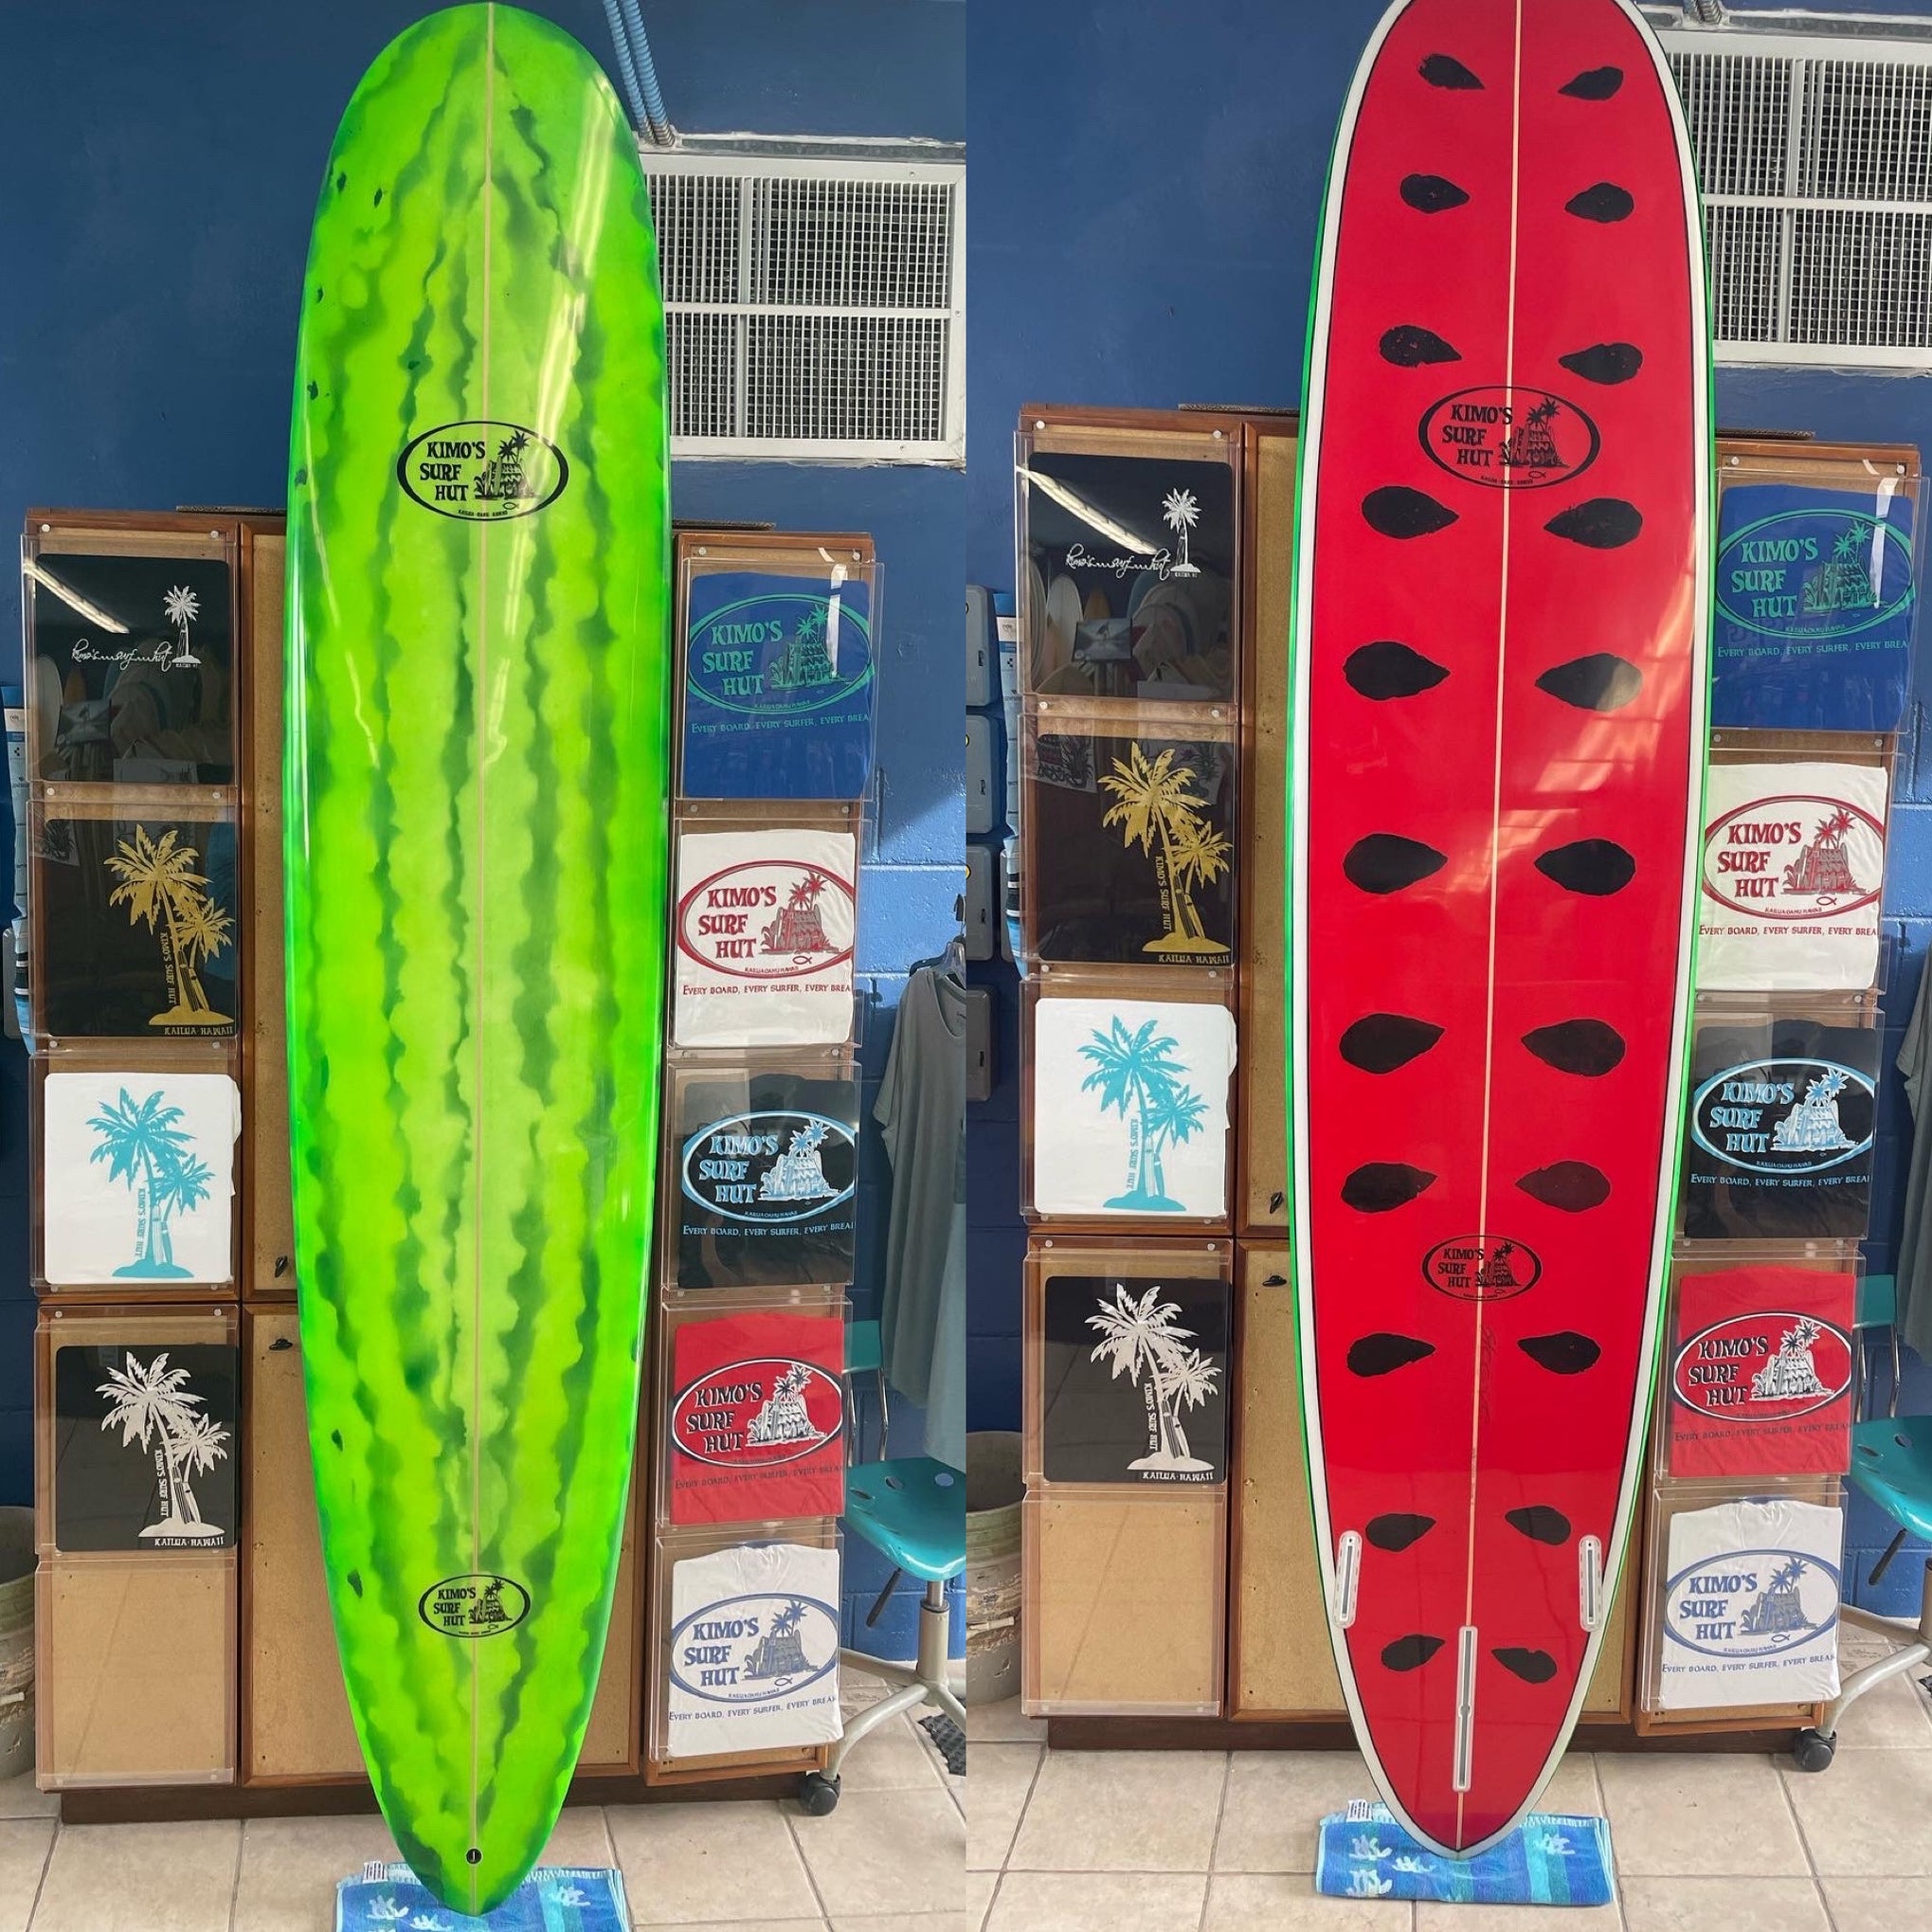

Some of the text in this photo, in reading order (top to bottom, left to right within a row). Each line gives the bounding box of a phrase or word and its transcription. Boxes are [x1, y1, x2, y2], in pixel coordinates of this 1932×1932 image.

[1451, 404, 1513, 424] KIMO'S
[1442, 425, 1487, 446] SURF
[426, 441, 486, 460] KIMO'S
[1457, 448, 1493, 467] HUT
[420, 463, 461, 481] SURF
[435, 484, 469, 501] HUT
[1741, 537, 1818, 564] KIMO'S
[1730, 569, 1787, 593] SURF
[1752, 595, 1797, 618] HUT
[711, 620, 783, 645] KIMO'S
[1786, 645, 1812, 655] EVERY
[1816, 643, 1851, 653] SURFER,
[1855, 641, 1881, 650] EVERY
[702, 650, 754, 673] SURF
[721, 674, 765, 695] HUT
[755, 720, 780, 729] EVERY
[821, 715, 844, 725] EVERY
[1727, 822, 1802, 844] KIMO'S
[1718, 851, 1771, 874] SURF
[707, 886, 777, 909] KIMO'S
[1156, 856, 1172, 931] KIMO'S SURF HUT
[1735, 877, 1779, 898] HUT
[697, 913, 749, 936] SURF
[1727, 927, 1759, 935] BOARD,
[1763, 927, 1788, 935] EVERY
[1792, 927, 1824, 935] SURFER,
[1828, 927, 1853, 935] EVERY
[715, 938, 757, 959] HUT
[160, 931, 177, 1004] KIMO'S SURF HUT
[1158, 954, 1229, 965] KAILUA HAWAII
[711, 985, 741, 995] BOARD,
[744, 984, 767, 993] EVERY
[770, 984, 802, 993] SURFER,
[805, 984, 828, 992] EVERY
[164, 1026, 233, 1036] KAILUA HAWAII
[1721, 1082, 1795, 1105] KIMO'S
[1709, 1107, 1763, 1129] SURF
[709, 1134, 780, 1156] KIMO'S
[1725, 1133, 1770, 1153] HUT
[698, 1159, 749, 1181] SURF
[1720, 1177, 1751, 1186] BOARD,
[1783, 1179, 1815, 1188] SURFER,
[714, 1183, 757, 1204] HUT
[711, 1227, 741, 1237] BOARD,
[770, 1227, 802, 1236] SURFER,
[804, 1224, 827, 1234] EVERY
[1443, 1248, 1484, 1260] KIMO'S
[1438, 1262, 1466, 1274] SURF
[1448, 1276, 1471, 1288] HUT
[1698, 1336, 1769, 1360] KIMO'S
[1688, 1364, 1740, 1386] SURF
[694, 1382, 763, 1408] KIMO'S
[1706, 1385, 1748, 1407] HUT
[686, 1411, 735, 1434] SURF
[703, 1432, 744, 1454] HUT
[1143, 1472, 1214, 1481] KAILUA HAWAII
[154, 1537, 224, 1546] KAILUA HAWAII
[438, 1587, 477, 1600] KIMO'S
[1688, 1573, 1758, 1594] KIMO'S
[433, 1602, 461, 1615] SURF
[1679, 1599, 1728, 1619] SURF
[443, 1615, 465, 1626] HUT
[693, 1617, 759, 1640] KIMO'S
[1695, 1621, 1736, 1640] HUT
[683, 1645, 731, 1667] SURF
[1722, 1663, 1746, 1671] EVERY
[1783, 1658, 1806, 1667] EVERY
[700, 1667, 739, 1687] HUT
[728, 1707, 751, 1717] EVERY
[753, 1705, 784, 1714] SURFER,
[786, 1701, 810, 1710] EVERY
